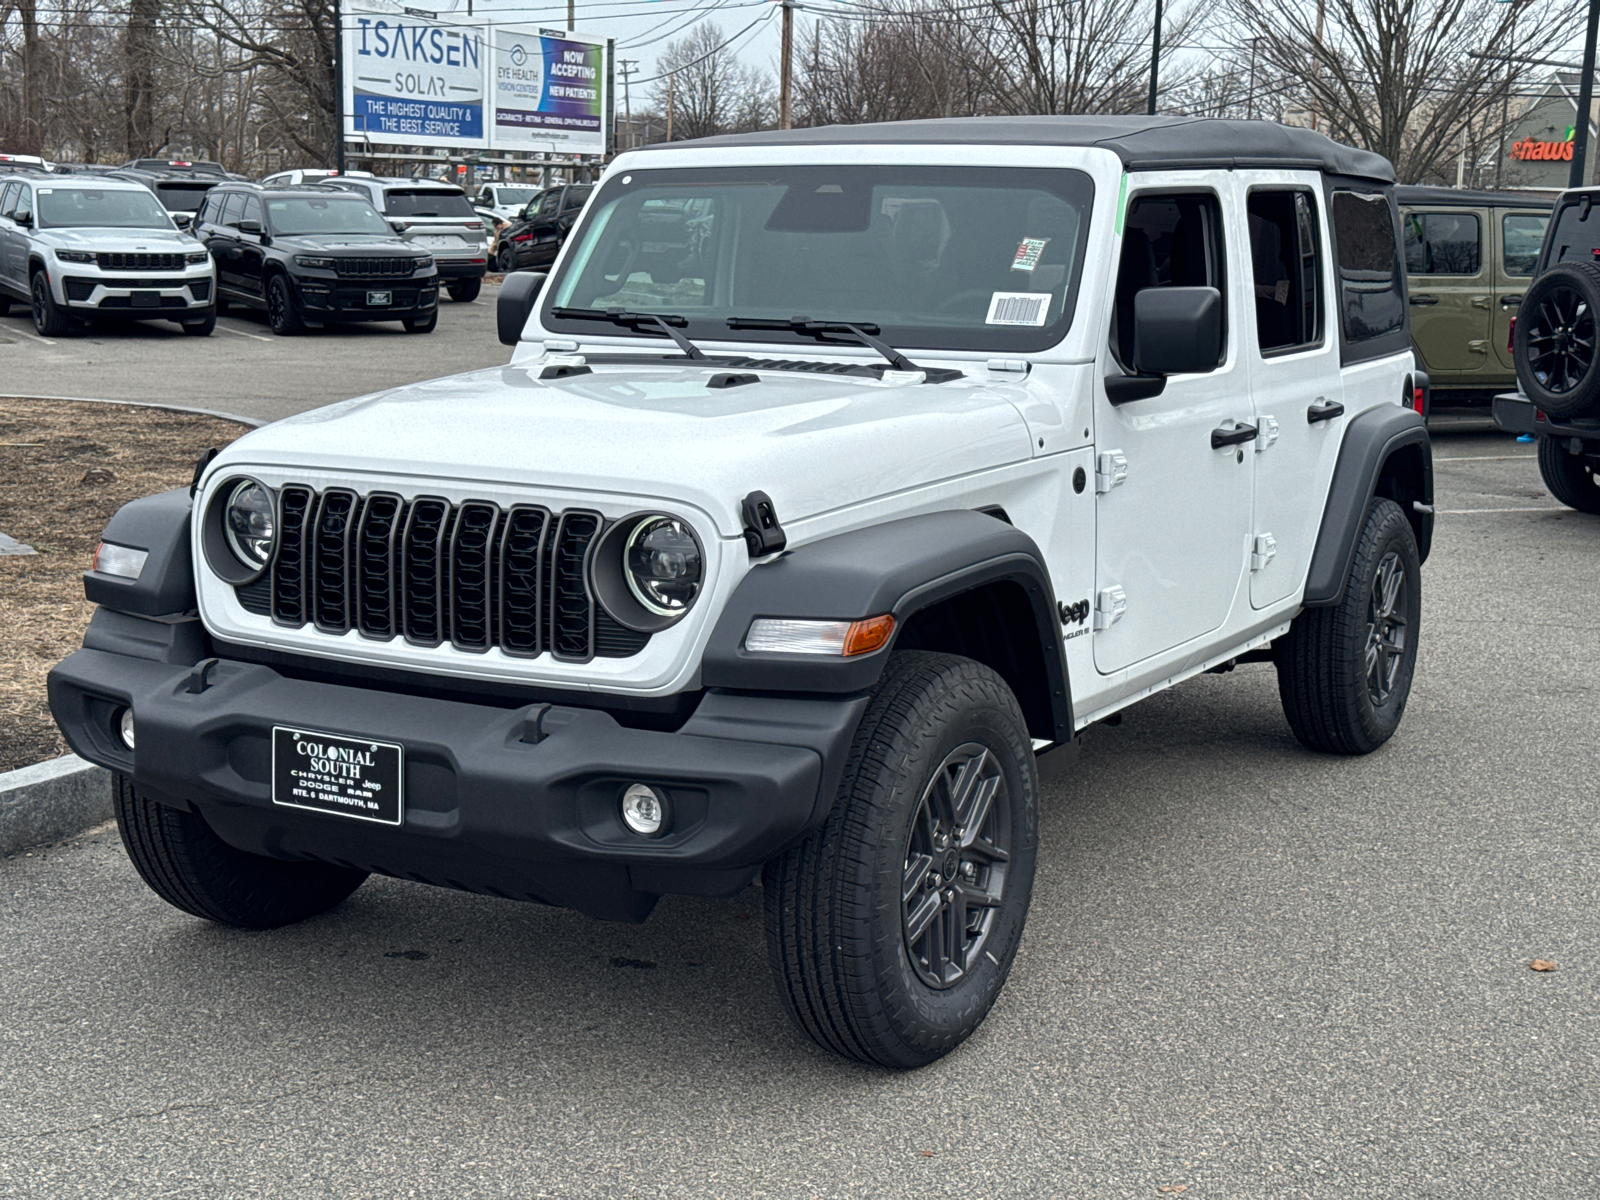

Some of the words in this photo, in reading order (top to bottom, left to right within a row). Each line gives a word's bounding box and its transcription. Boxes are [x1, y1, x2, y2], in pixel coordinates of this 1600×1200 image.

[358, 18, 478, 69] ISAKSEN
[563, 50, 584, 64] NOW
[498, 67, 511, 79] EYE
[512, 69, 539, 82] HEALTH
[550, 63, 596, 79] ACCEPTING
[395, 72, 446, 96] SOLAR
[498, 82, 515, 92] VISION
[516, 84, 538, 94] CENTERS
[549, 85, 564, 97] NEW
[366, 100, 385, 114] THE
[388, 102, 426, 118] HIGHEST
[428, 105, 464, 121] QUALITY
[465, 109, 471, 121] &
[380, 117, 398, 131] THE
[400, 119, 422, 132] BEST
[424, 121, 460, 135] SERVICE
[310, 758, 361, 779] SOUTH
[290, 769, 355, 786] CHRYSLER
[362, 779, 382, 791] Jeep
[299, 779, 339, 792] DODGE
[347, 788, 373, 798] RAM
[293, 788, 309, 798] RTE.
[311, 791, 316, 799] 6
[319, 792, 366, 809] DARTMOUTH,
[368, 801, 380, 810] MA
